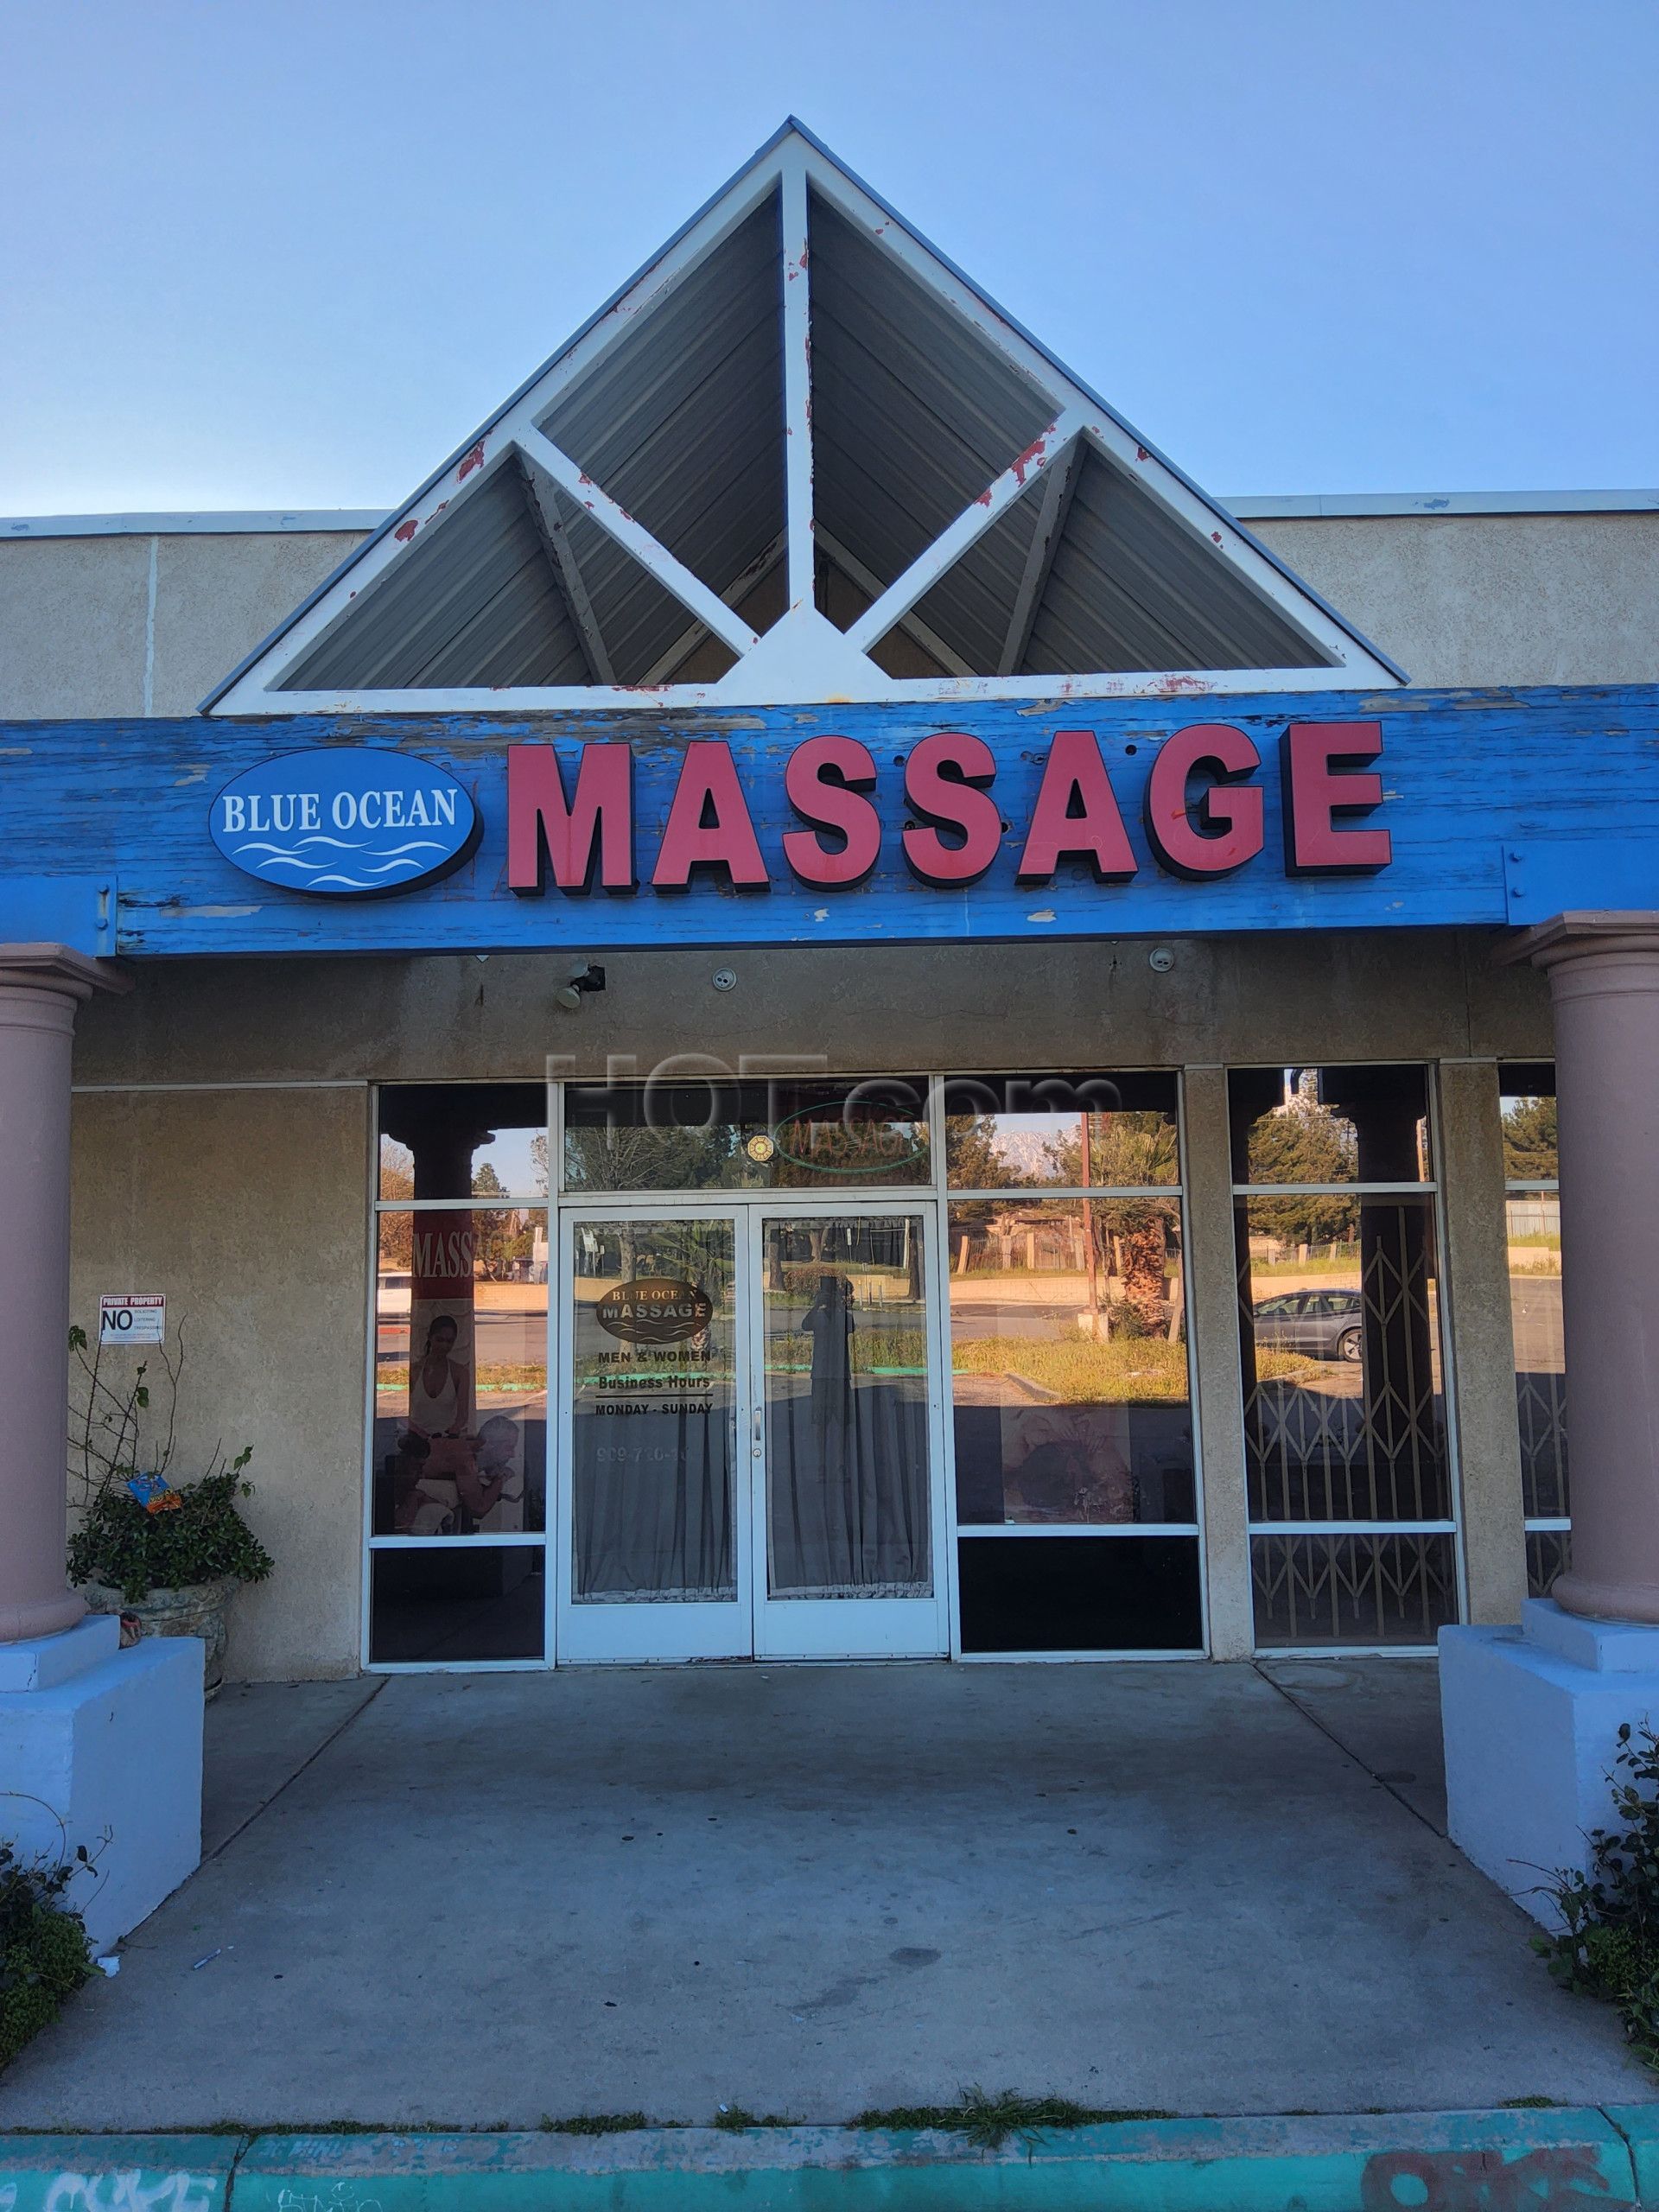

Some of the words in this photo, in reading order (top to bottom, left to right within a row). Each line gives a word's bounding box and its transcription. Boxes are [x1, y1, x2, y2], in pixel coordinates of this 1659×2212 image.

[222, 793, 321, 833] BLUE
[332, 788, 458, 830] OCEAN
[506, 721, 1392, 896] MASSAGE
[602, 1303, 707, 1319] MASSAGE
[102, 1309, 133, 1331] NO
[598, 1352, 632, 1363] MEN
[637, 1352, 647, 1363] &
[653, 1351, 711, 1363] WOMEN
[599, 1376, 663, 1389] Business
[669, 1376, 710, 1389] Hours
[595, 1404, 649, 1415] MONDAY
[662, 1403, 713, 1415] SUNDAY
